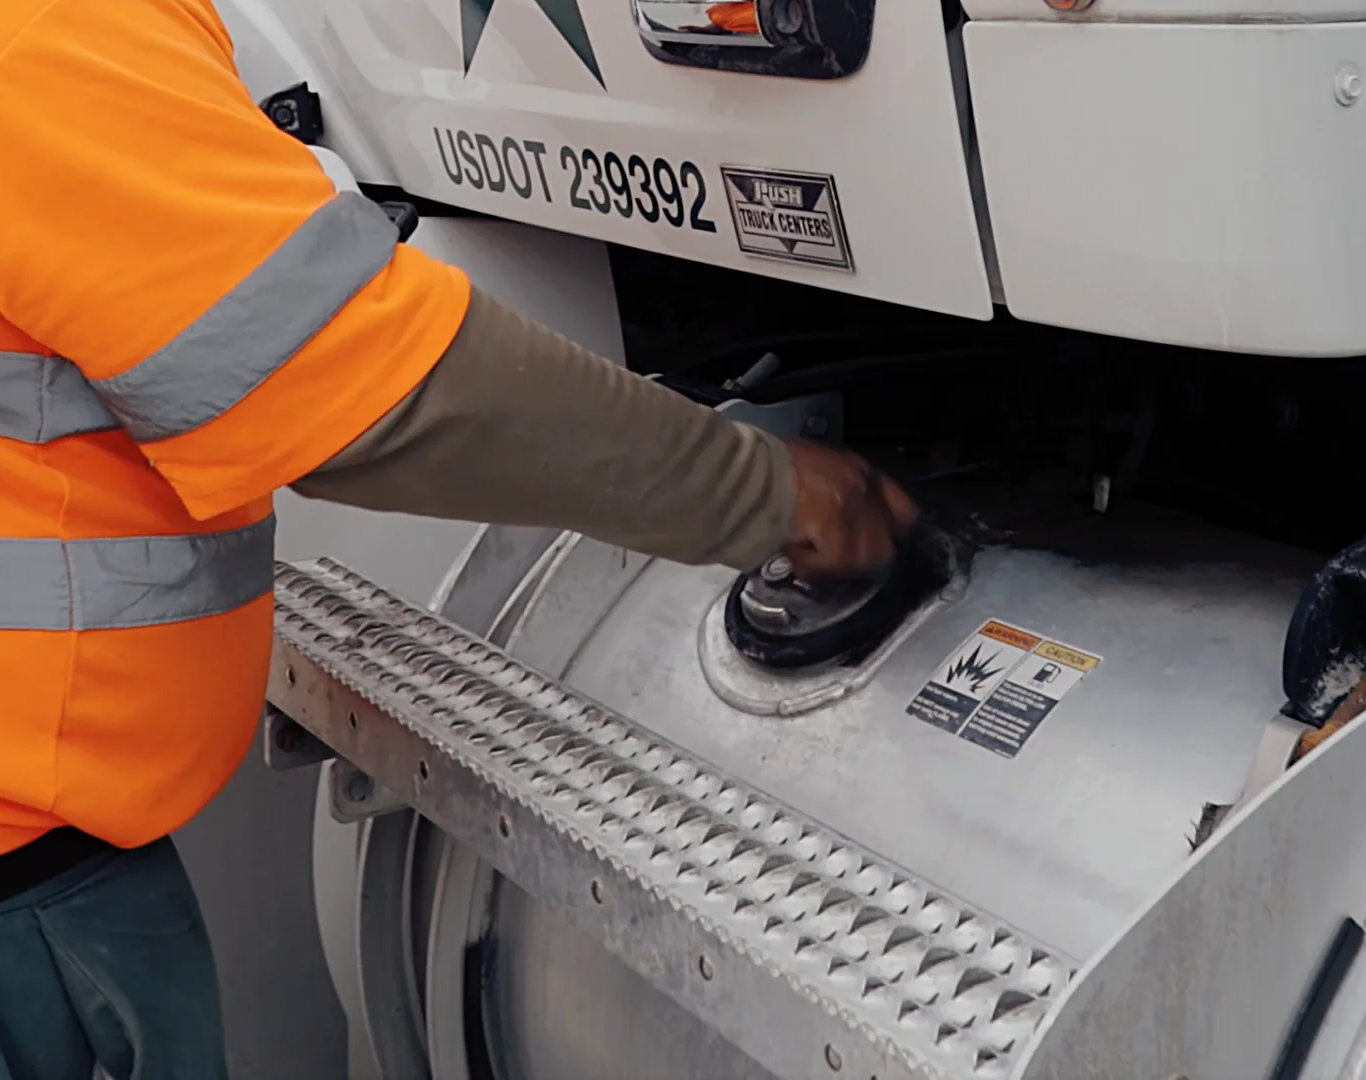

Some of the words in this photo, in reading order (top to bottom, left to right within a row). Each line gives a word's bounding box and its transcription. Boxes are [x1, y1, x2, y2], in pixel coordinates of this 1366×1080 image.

[433, 127, 553, 204] USDOT
[560, 145, 717, 233] 239392
[739, 207, 776, 231] TRUCK
[777, 213, 832, 238] CENTERS
[1045, 646, 1088, 666] CAUTION
